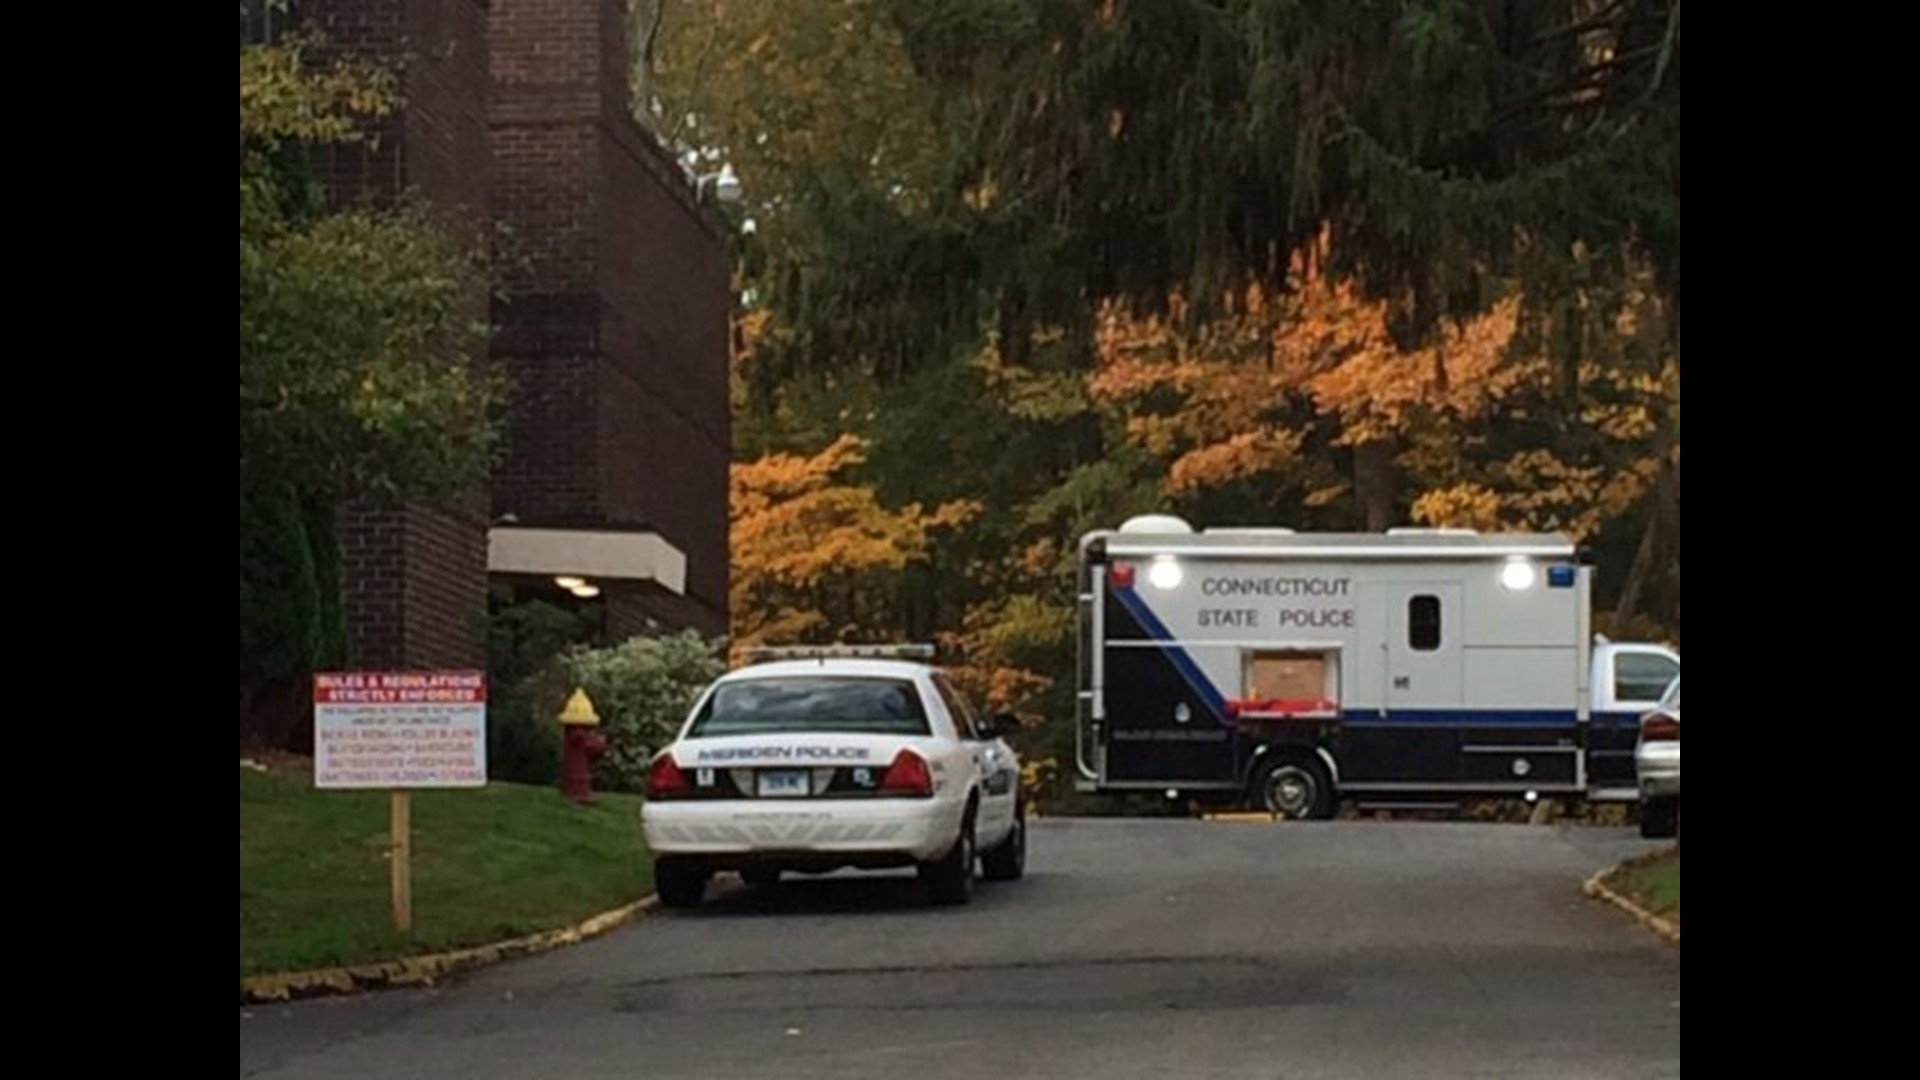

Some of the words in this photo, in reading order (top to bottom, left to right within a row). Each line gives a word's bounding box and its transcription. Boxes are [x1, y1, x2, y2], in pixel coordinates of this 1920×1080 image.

[1201, 577, 1352, 596] CONNECTICUT
[1198, 609, 1259, 627] STATE
[1279, 609, 1355, 627] POLICE
[382, 675, 482, 687] REGULATIONS
[328, 689, 396, 701] STRICTLY
[399, 689, 476, 701] ENFORCED
[697, 745, 792, 761] MERIDEN
[795, 746, 870, 760] POLICE
